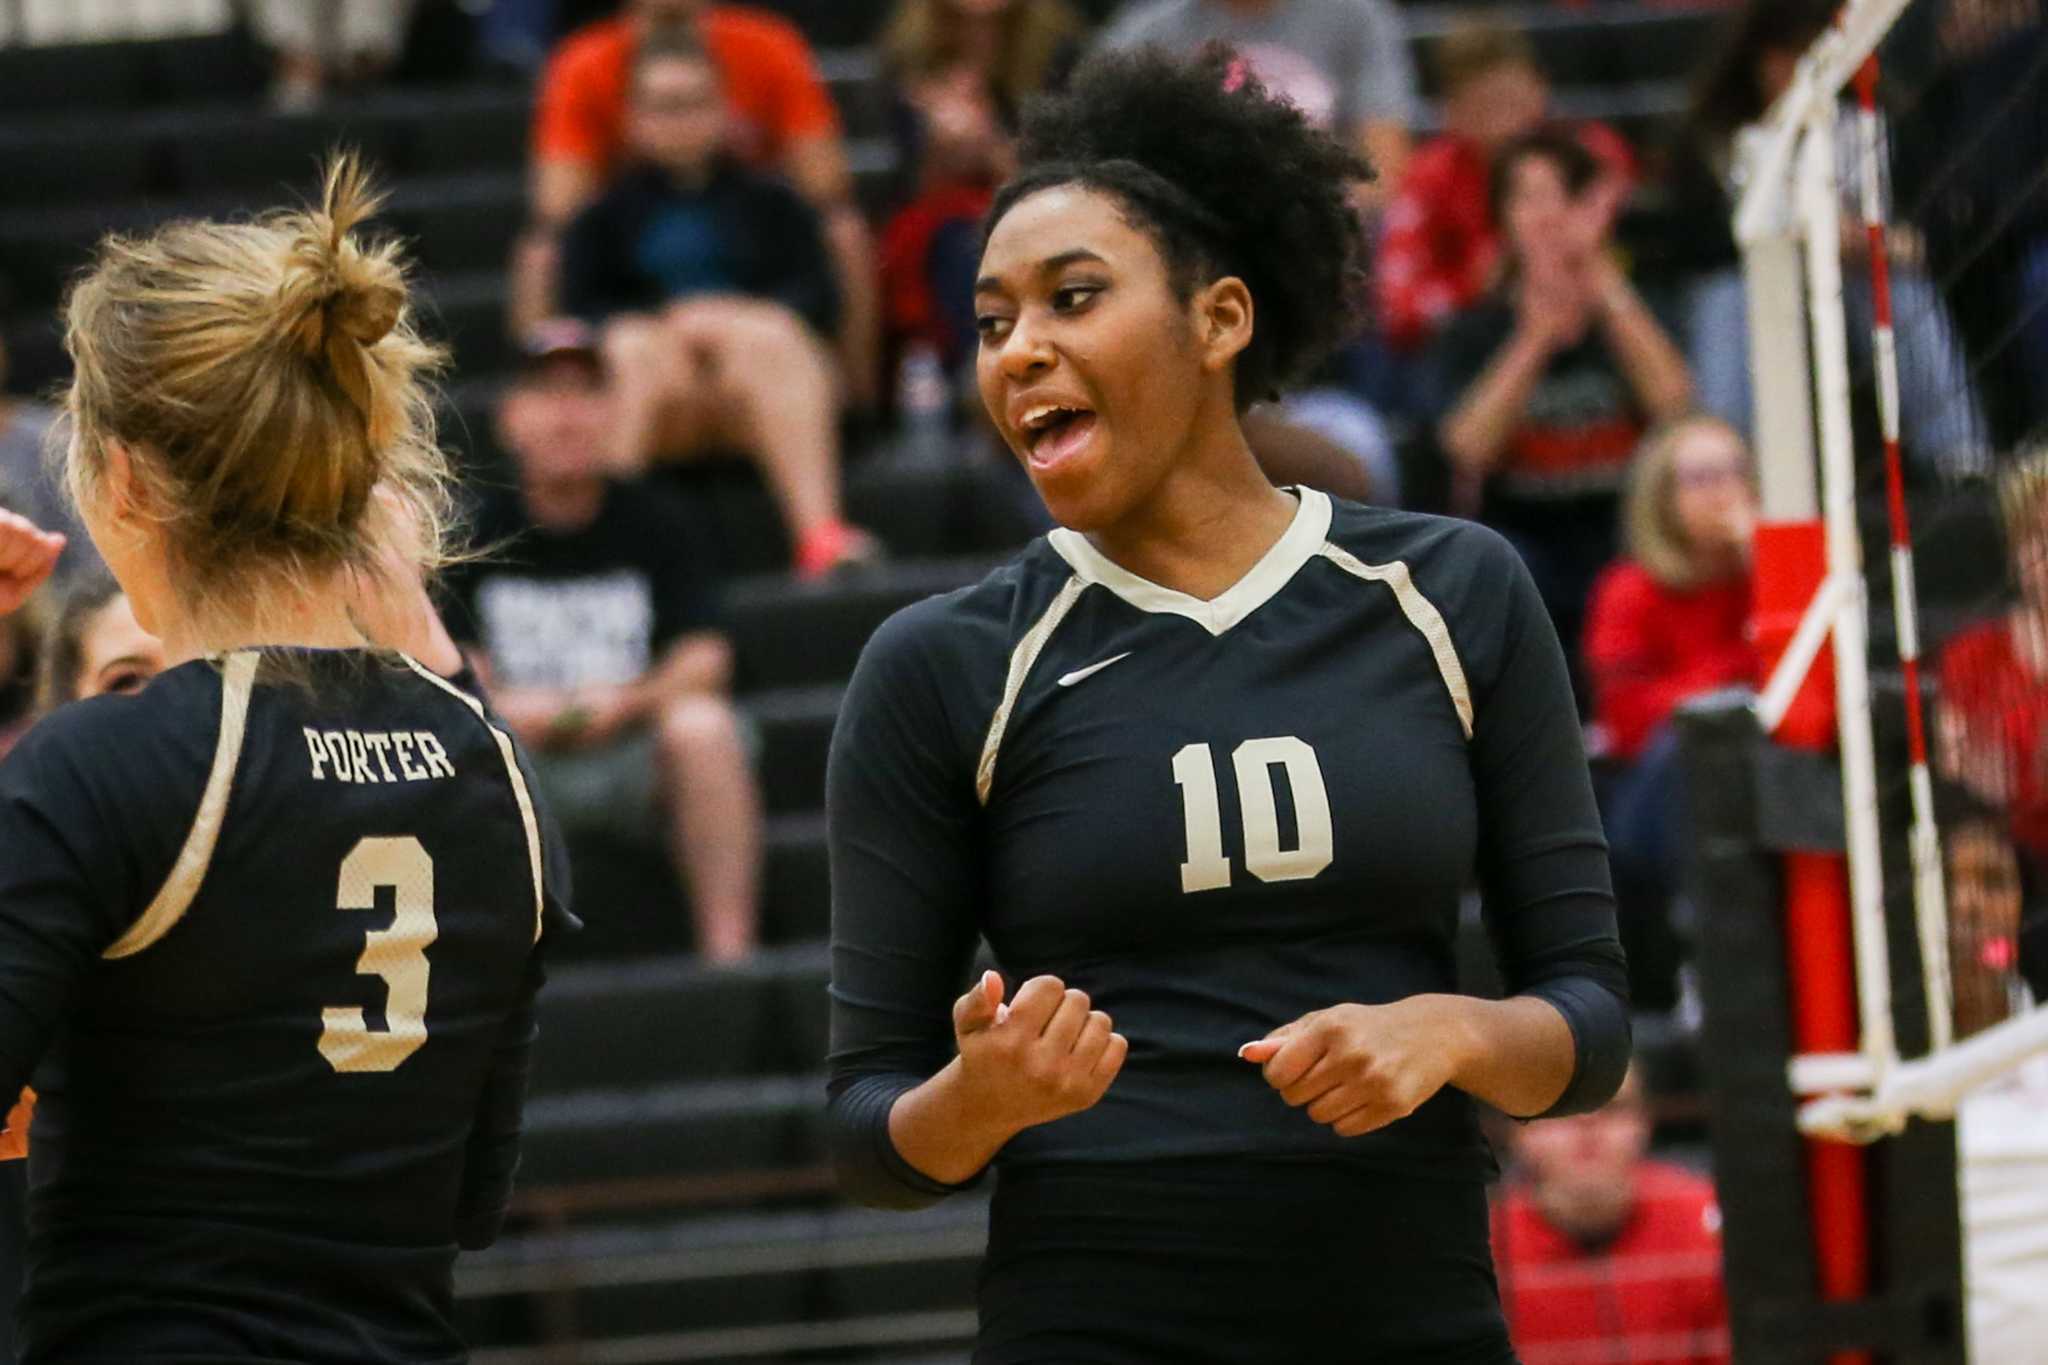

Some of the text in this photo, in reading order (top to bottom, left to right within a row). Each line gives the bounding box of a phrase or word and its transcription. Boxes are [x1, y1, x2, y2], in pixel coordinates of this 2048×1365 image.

[303, 726, 455, 783] PORTER
[1172, 736, 1333, 893] 10
[317, 836, 438, 1073] 3
